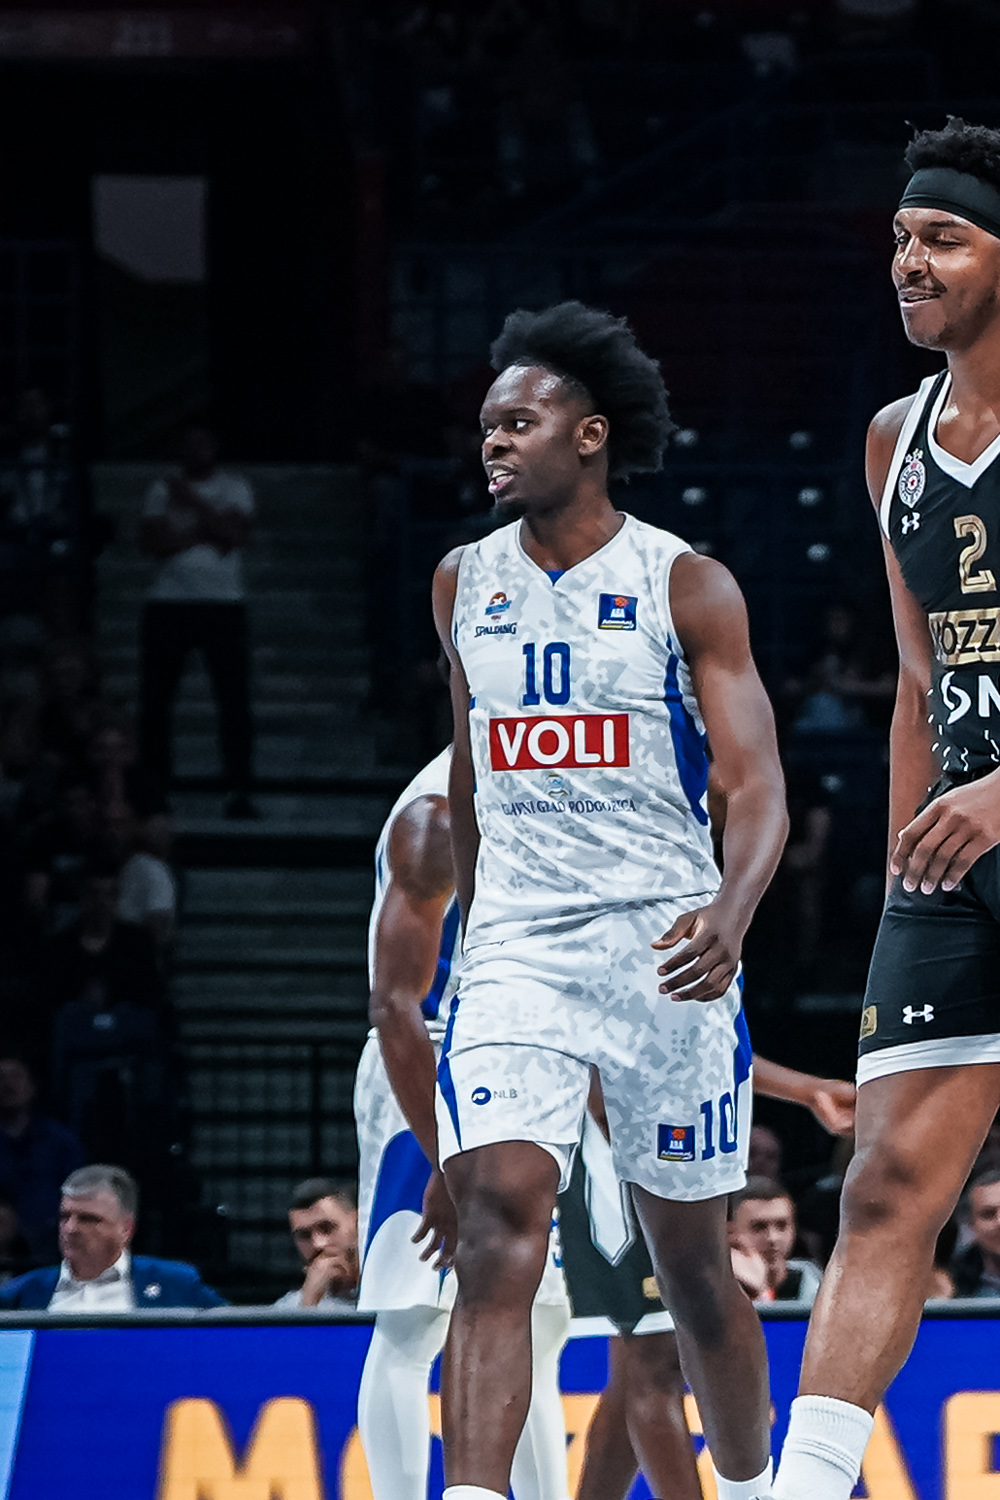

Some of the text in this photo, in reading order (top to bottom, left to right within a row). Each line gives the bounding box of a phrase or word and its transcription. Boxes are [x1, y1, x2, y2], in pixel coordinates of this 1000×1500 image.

[953, 514, 997, 594] 2
[474, 622, 518, 638] SPALDING
[522, 642, 571, 706] 10
[498, 719, 616, 766] VOLI
[493, 1088, 518, 1099] NLB
[700, 1092, 738, 1161] 10
